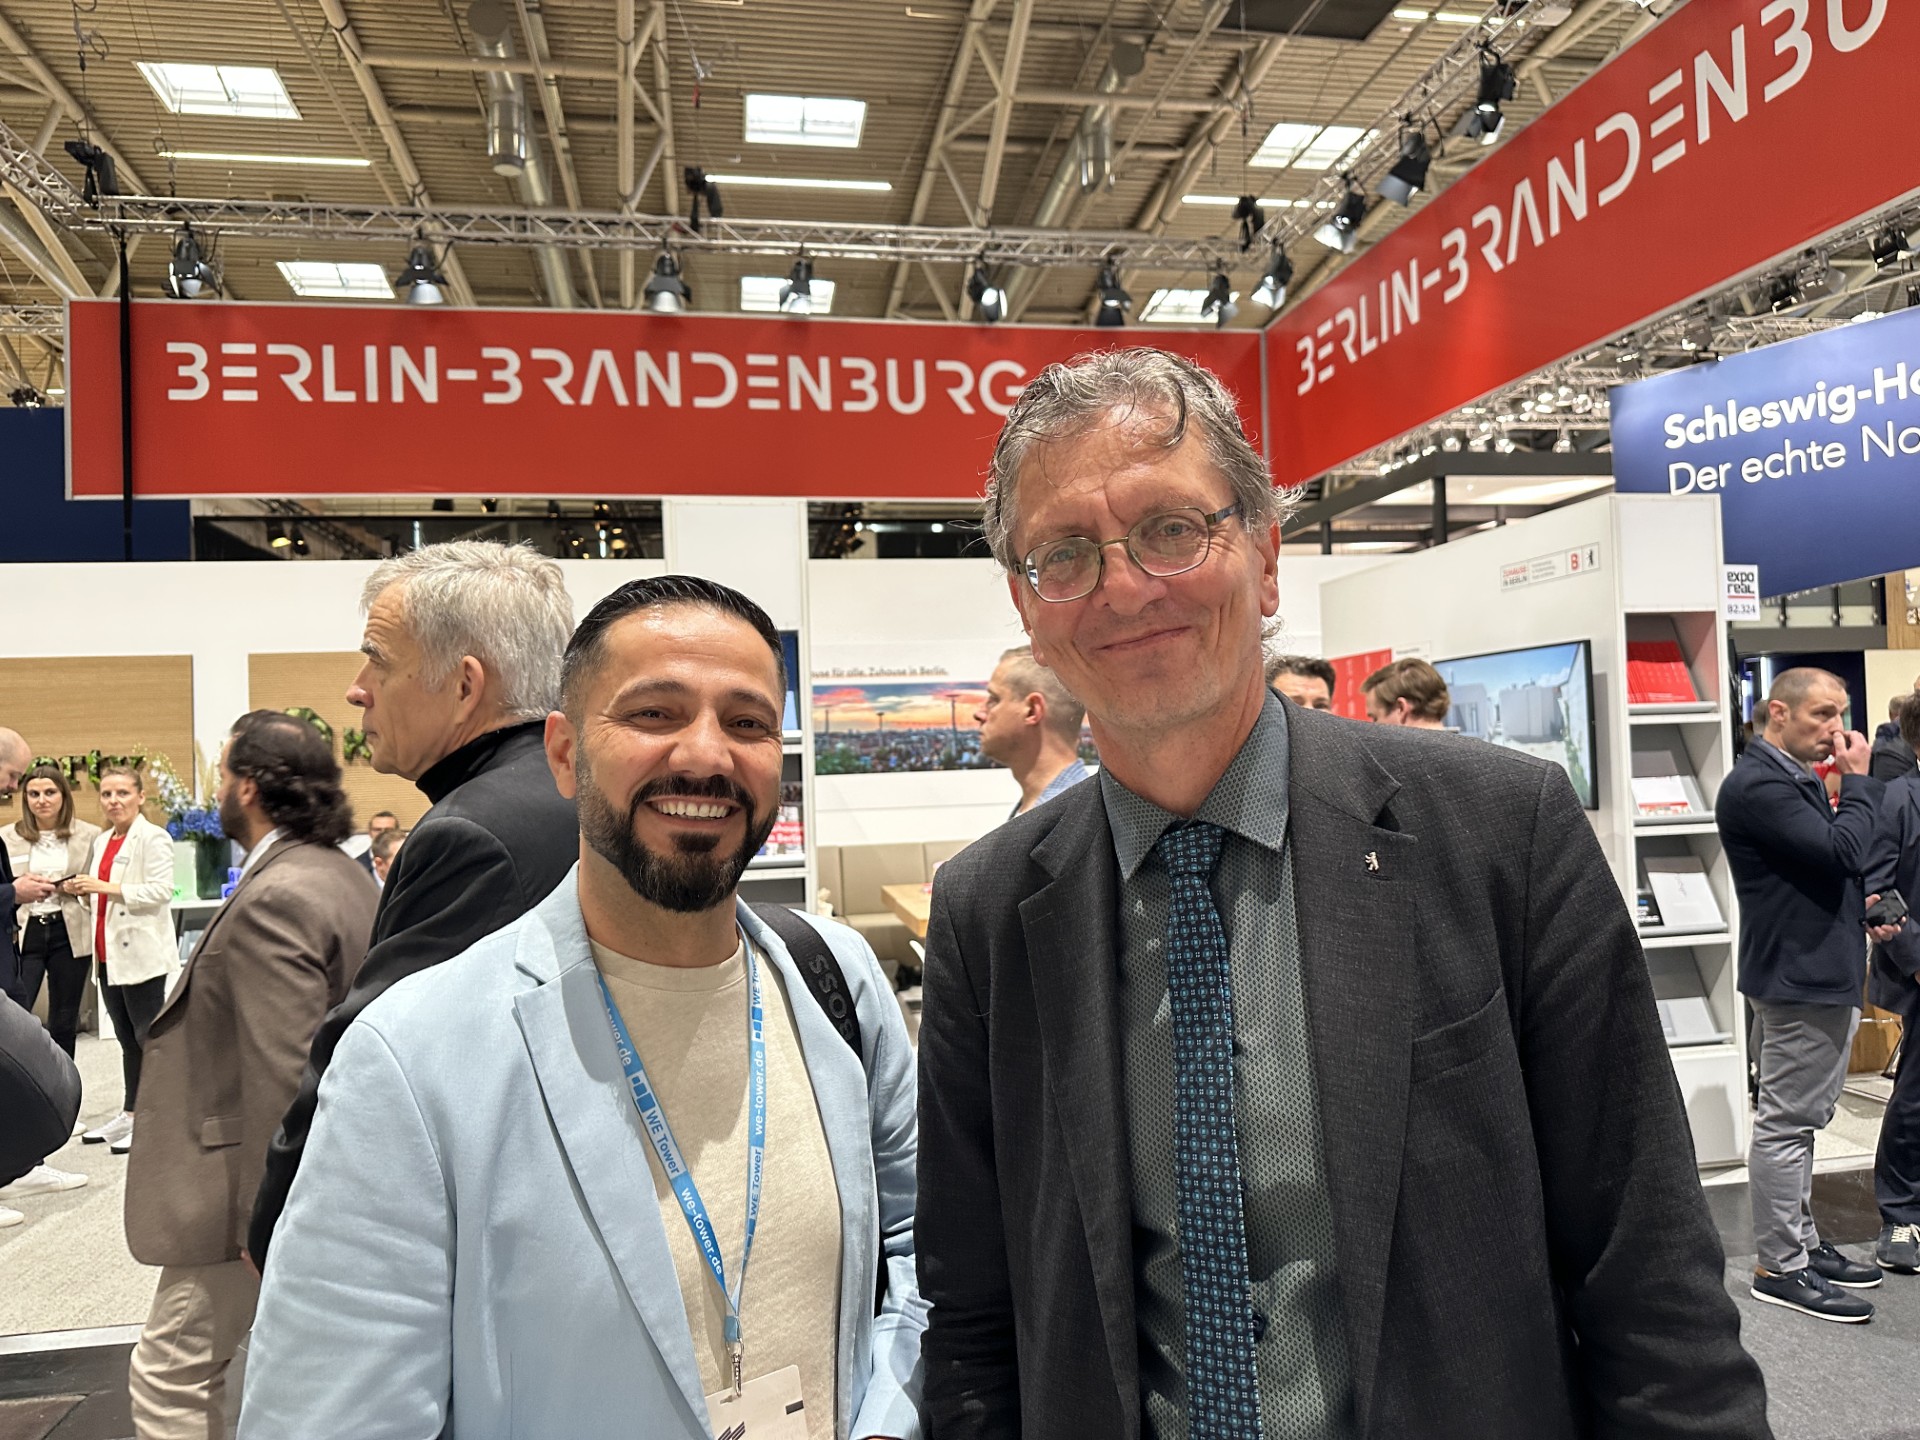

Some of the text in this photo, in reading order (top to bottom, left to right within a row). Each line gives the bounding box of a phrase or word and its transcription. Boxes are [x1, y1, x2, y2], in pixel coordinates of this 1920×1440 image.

[166, 342, 1027, 416] BERLIN-BRANDENBURG
[1669, 461, 1732, 496] Der
[1741, 439, 1847, 483] echte
[1727, 571, 1755, 586] expo
[808, 954, 855, 1040] BOSS
[754, 1050, 765, 1136] we-tower.de
[645, 1110, 680, 1175] WE Tower
[750, 1149, 762, 1216] WE Tower
[681, 1187, 723, 1275] we-tower.de
